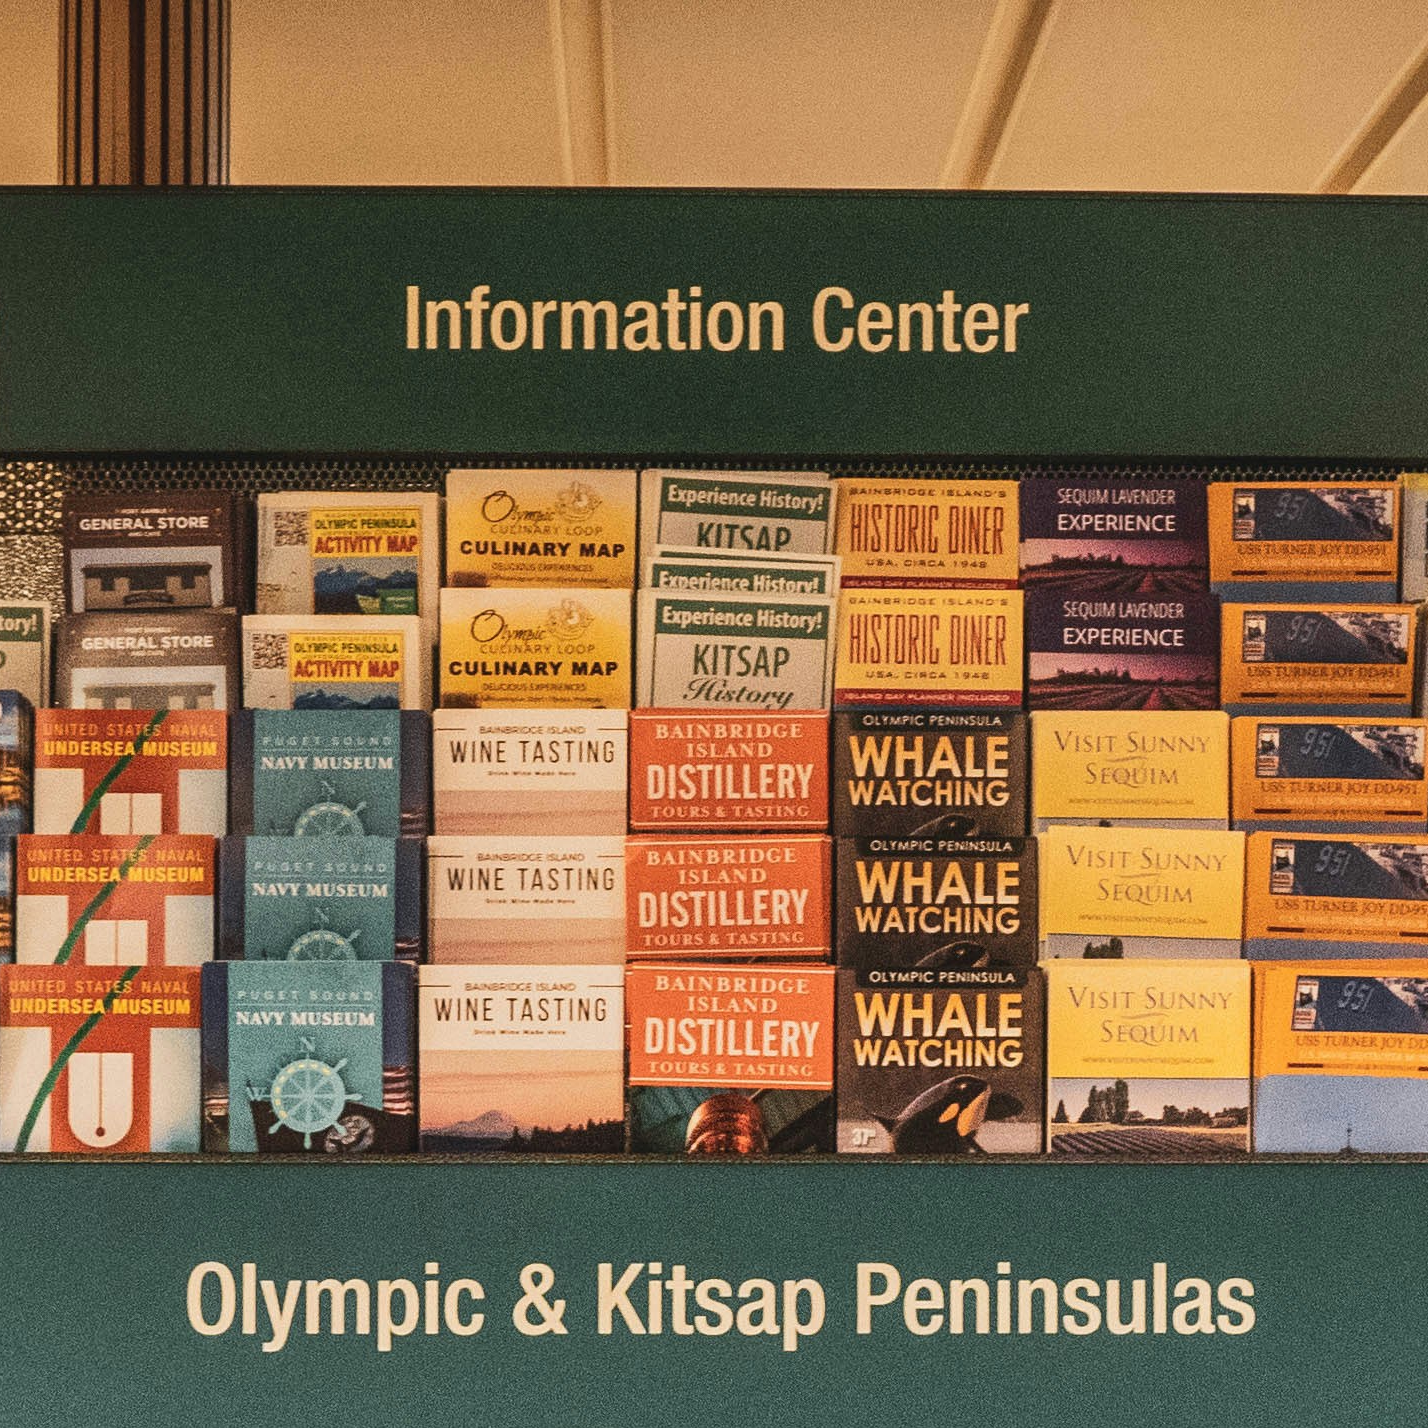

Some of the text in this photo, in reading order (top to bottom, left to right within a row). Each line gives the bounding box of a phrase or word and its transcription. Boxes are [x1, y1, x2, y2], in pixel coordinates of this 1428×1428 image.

[406, 285, 1029, 353] Information Center
[482, 490, 555, 523] Olympic
[667, 485, 823, 514] Experience History!
[1057, 488, 1175, 505] SEQUIM LAVENDER
[79, 515, 209, 531] GENERAL STORE
[850, 504, 1003, 555] HISTORIC DINER
[1057, 514, 1175, 531] EXPERIENCE
[315, 535, 418, 554] ACTIVITY MAP
[662, 606, 822, 633] Experience History!
[449, 660, 618, 676] CULINARY MAP
[694, 643, 790, 678] KITSAP
[683, 677, 794, 709] History
[849, 735, 1009, 778] WHALE
[647, 764, 813, 800] DISTILLERY
[849, 780, 1010, 807] WATCHING
[855, 861, 1019, 905] WHALE
[639, 889, 808, 928] DISTILLERY
[855, 906, 1020, 934] WATCHING
[10, 979, 66, 994] UNITED
[141, 979, 189, 994] NAVAL
[535, 982, 576, 991] ISLAND
[655, 975, 810, 995] BAINBRIDGE
[869, 970, 1015, 984] OLYMPIC PENINSULA
[10, 998, 190, 1015] UNDERSEA MUSEUM
[435, 998, 607, 1022] WINE TASTING
[687, 996, 778, 1014] ISLAND
[1068, 986, 1233, 1010] VISIT SUNNY
[236, 1010, 375, 1027] NAVY MUSEUM
[854, 993, 1023, 1038] WHALE
[645, 1018, 819, 1058] DISTILLERY
[1101, 1020, 1199, 1047] SEQUIM
[853, 1039, 1023, 1068] WATCHING
[649, 1061, 710, 1075] TOURS
[732, 1062, 812, 1077] TASTING
[185, 1261, 1257, 1353] Olympic & Kitsap Peninsulas
